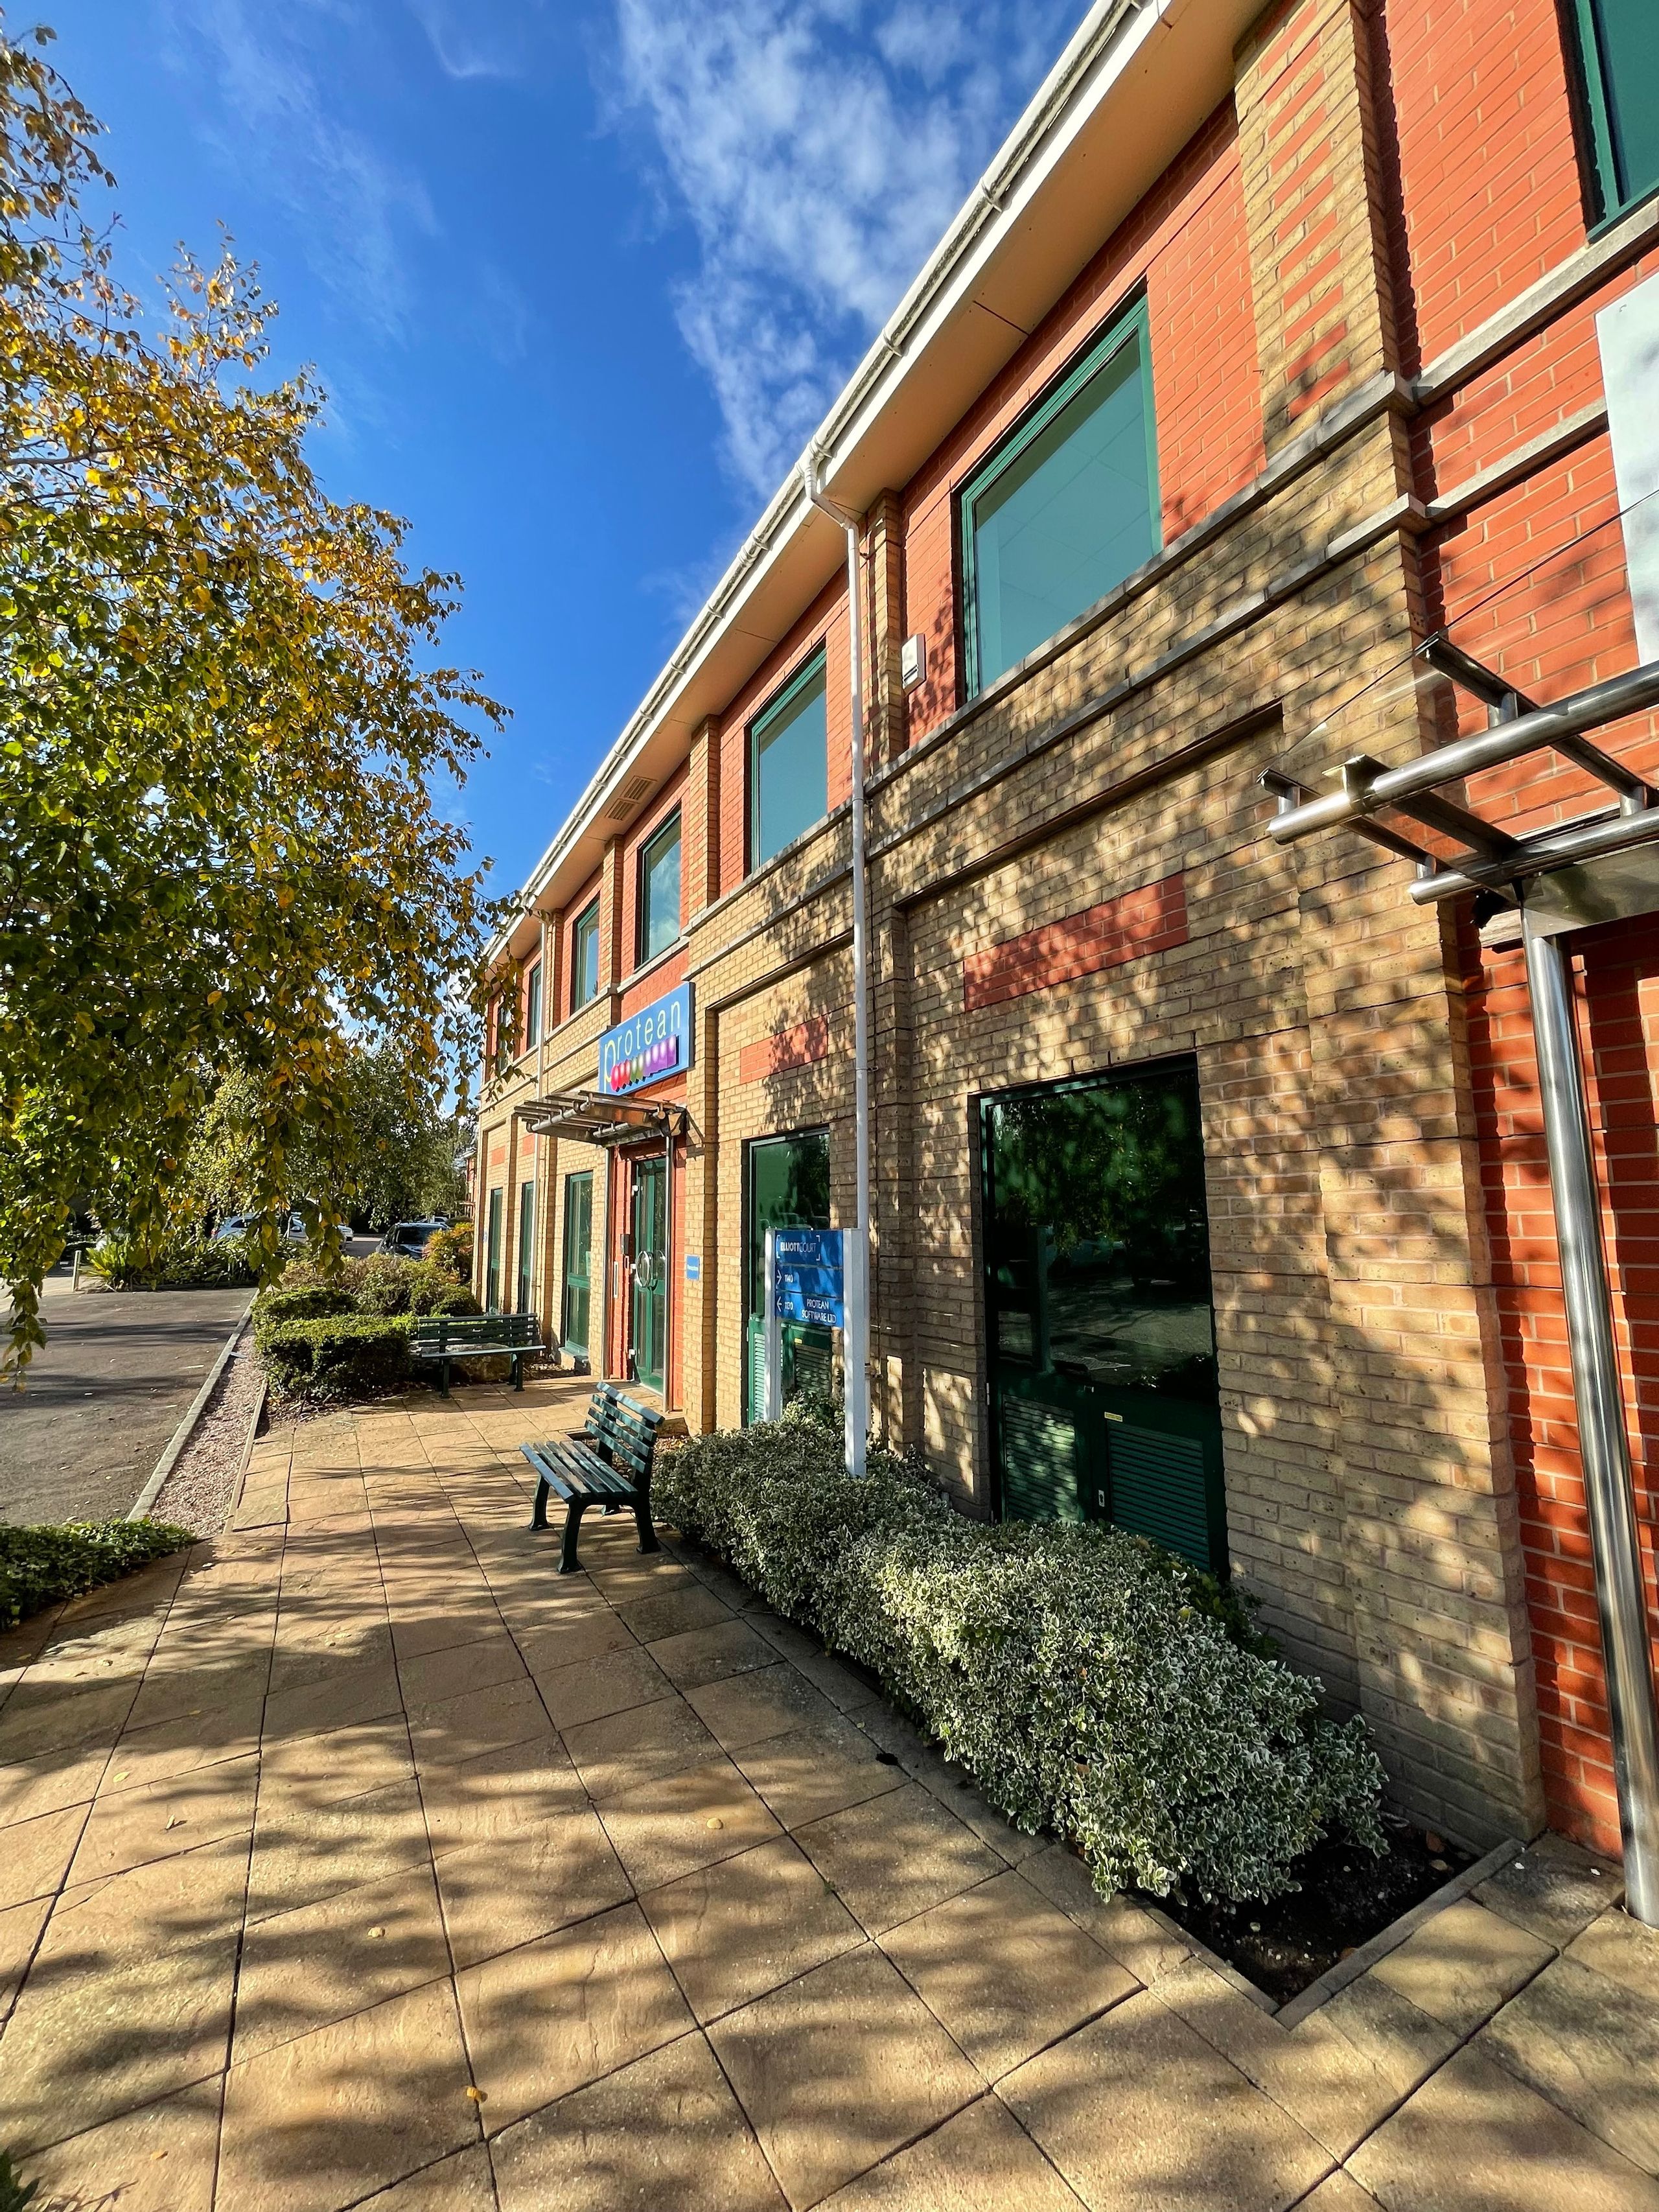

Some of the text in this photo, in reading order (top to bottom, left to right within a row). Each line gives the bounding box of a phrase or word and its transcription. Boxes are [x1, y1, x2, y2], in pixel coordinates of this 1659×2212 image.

[603, 1001, 680, 1094] protean
[784, 1274, 793, 1283] 1140
[807, 1298, 829, 1309] PROTEAN
[802, 1309, 836, 1323] SOFTWARE LTD
